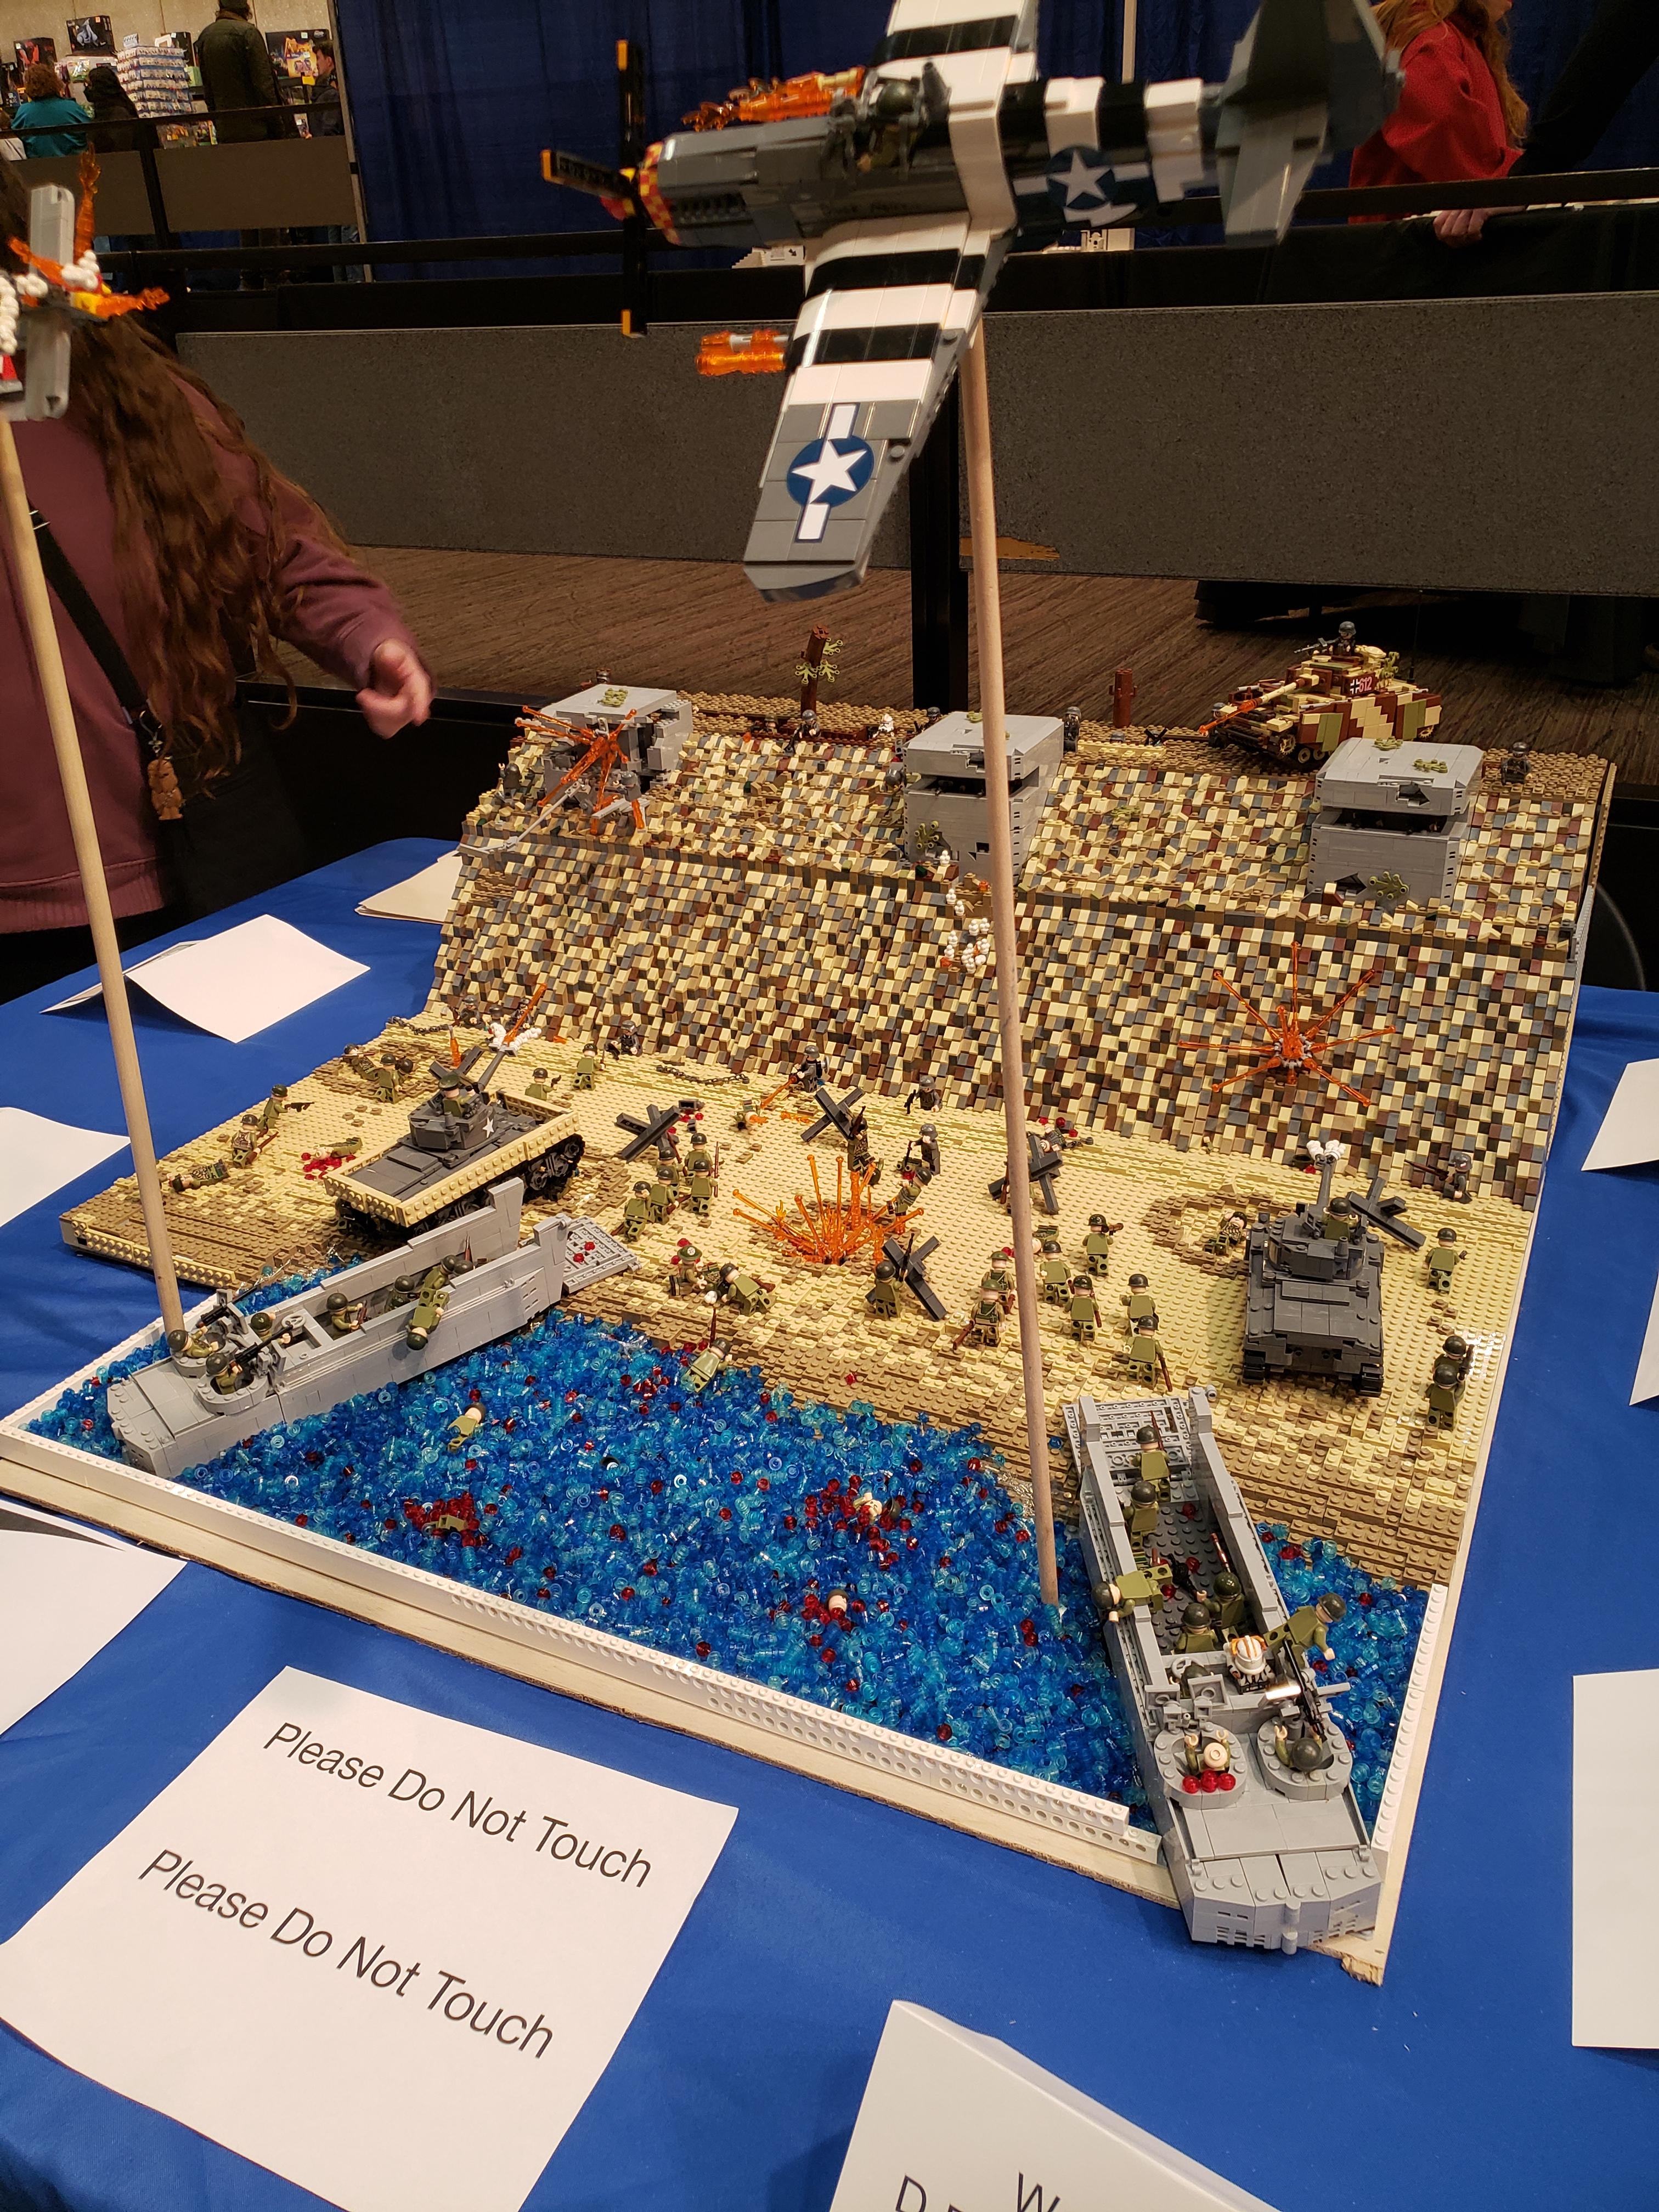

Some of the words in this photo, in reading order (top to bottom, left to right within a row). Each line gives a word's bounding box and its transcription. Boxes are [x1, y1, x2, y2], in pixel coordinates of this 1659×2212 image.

[1359, 676, 1372, 692] 612
[263, 1722, 384, 1787] Please
[388, 1769, 445, 1811] Do
[450, 1790, 527, 1842] Not
[535, 1816, 651, 1888] Touch
[138, 1849, 268, 1928] Please
[270, 1908, 332, 1957] Do
[337, 1936, 421, 1997] Not
[428, 1970, 552, 2058] Touch
